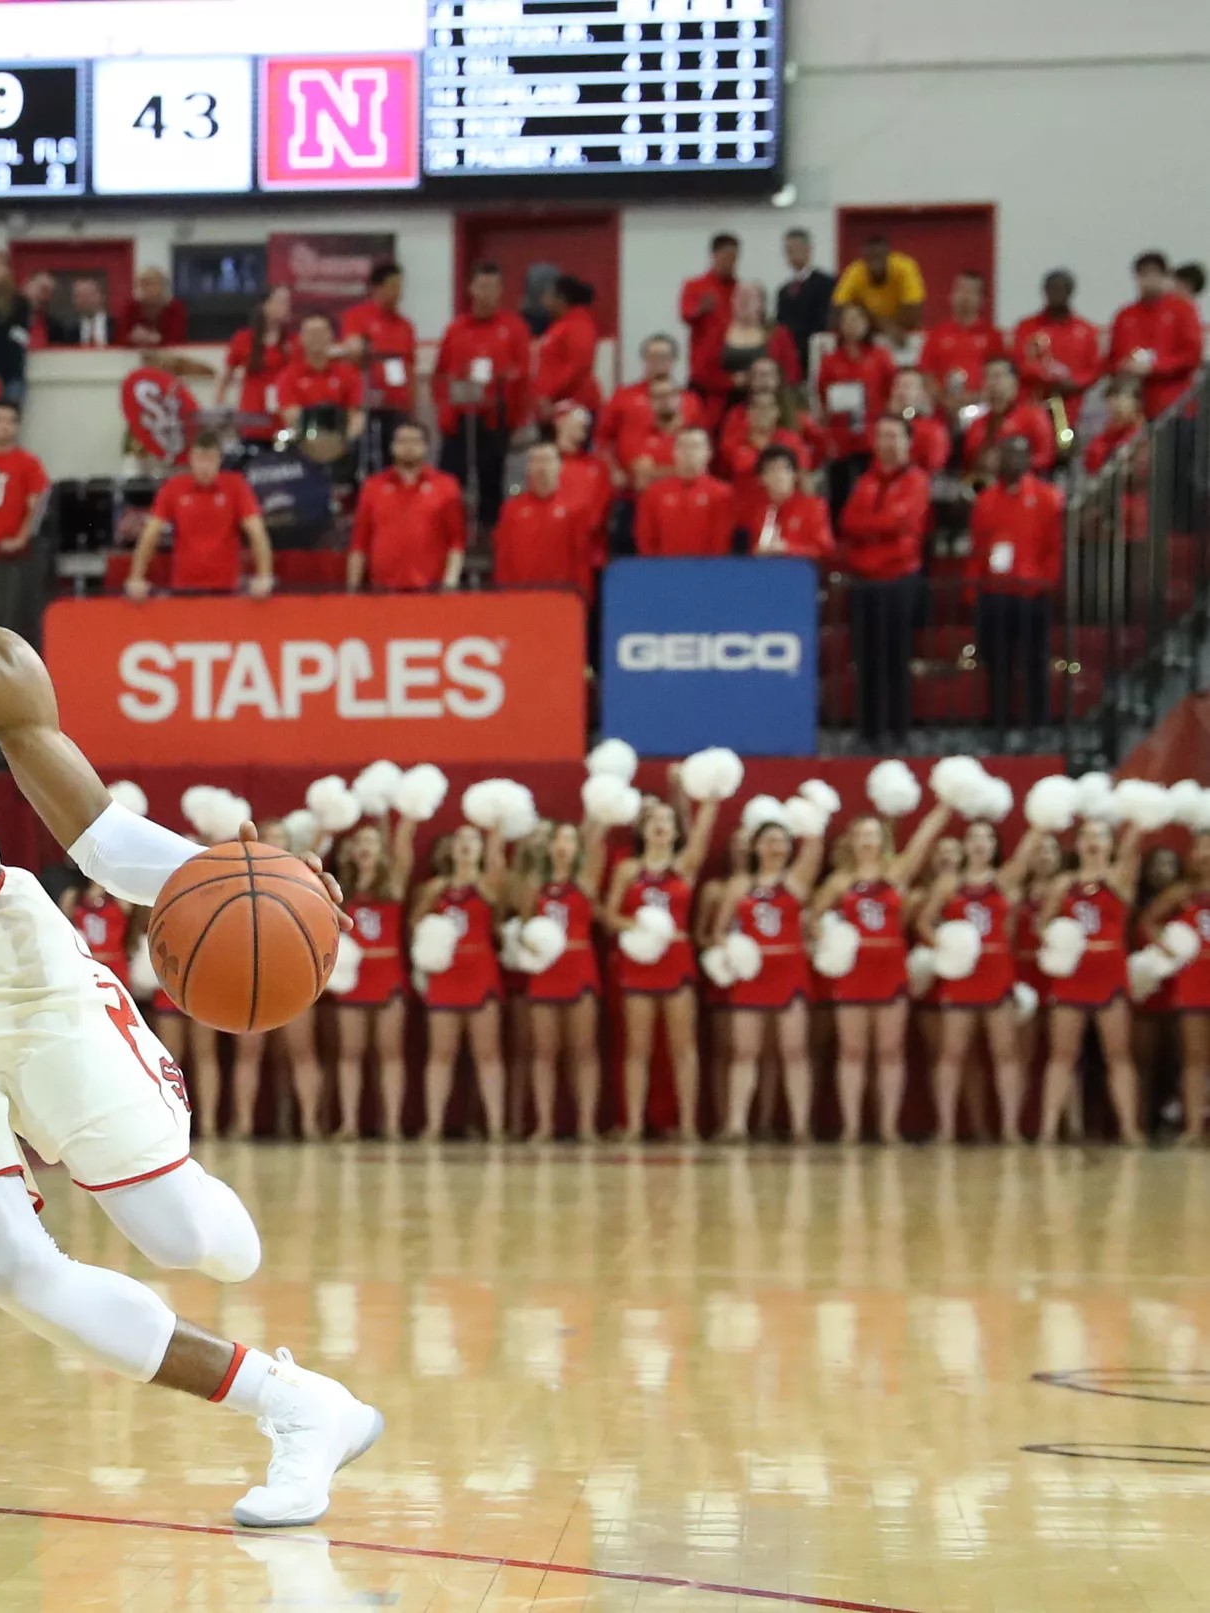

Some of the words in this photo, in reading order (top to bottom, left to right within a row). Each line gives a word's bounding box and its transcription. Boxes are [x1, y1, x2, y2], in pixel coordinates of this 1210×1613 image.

[132, 92, 219, 139] 43
[288, 68, 388, 169] N
[118, 636, 505, 723] STAPLES
[617, 632, 801, 675] GEICO
